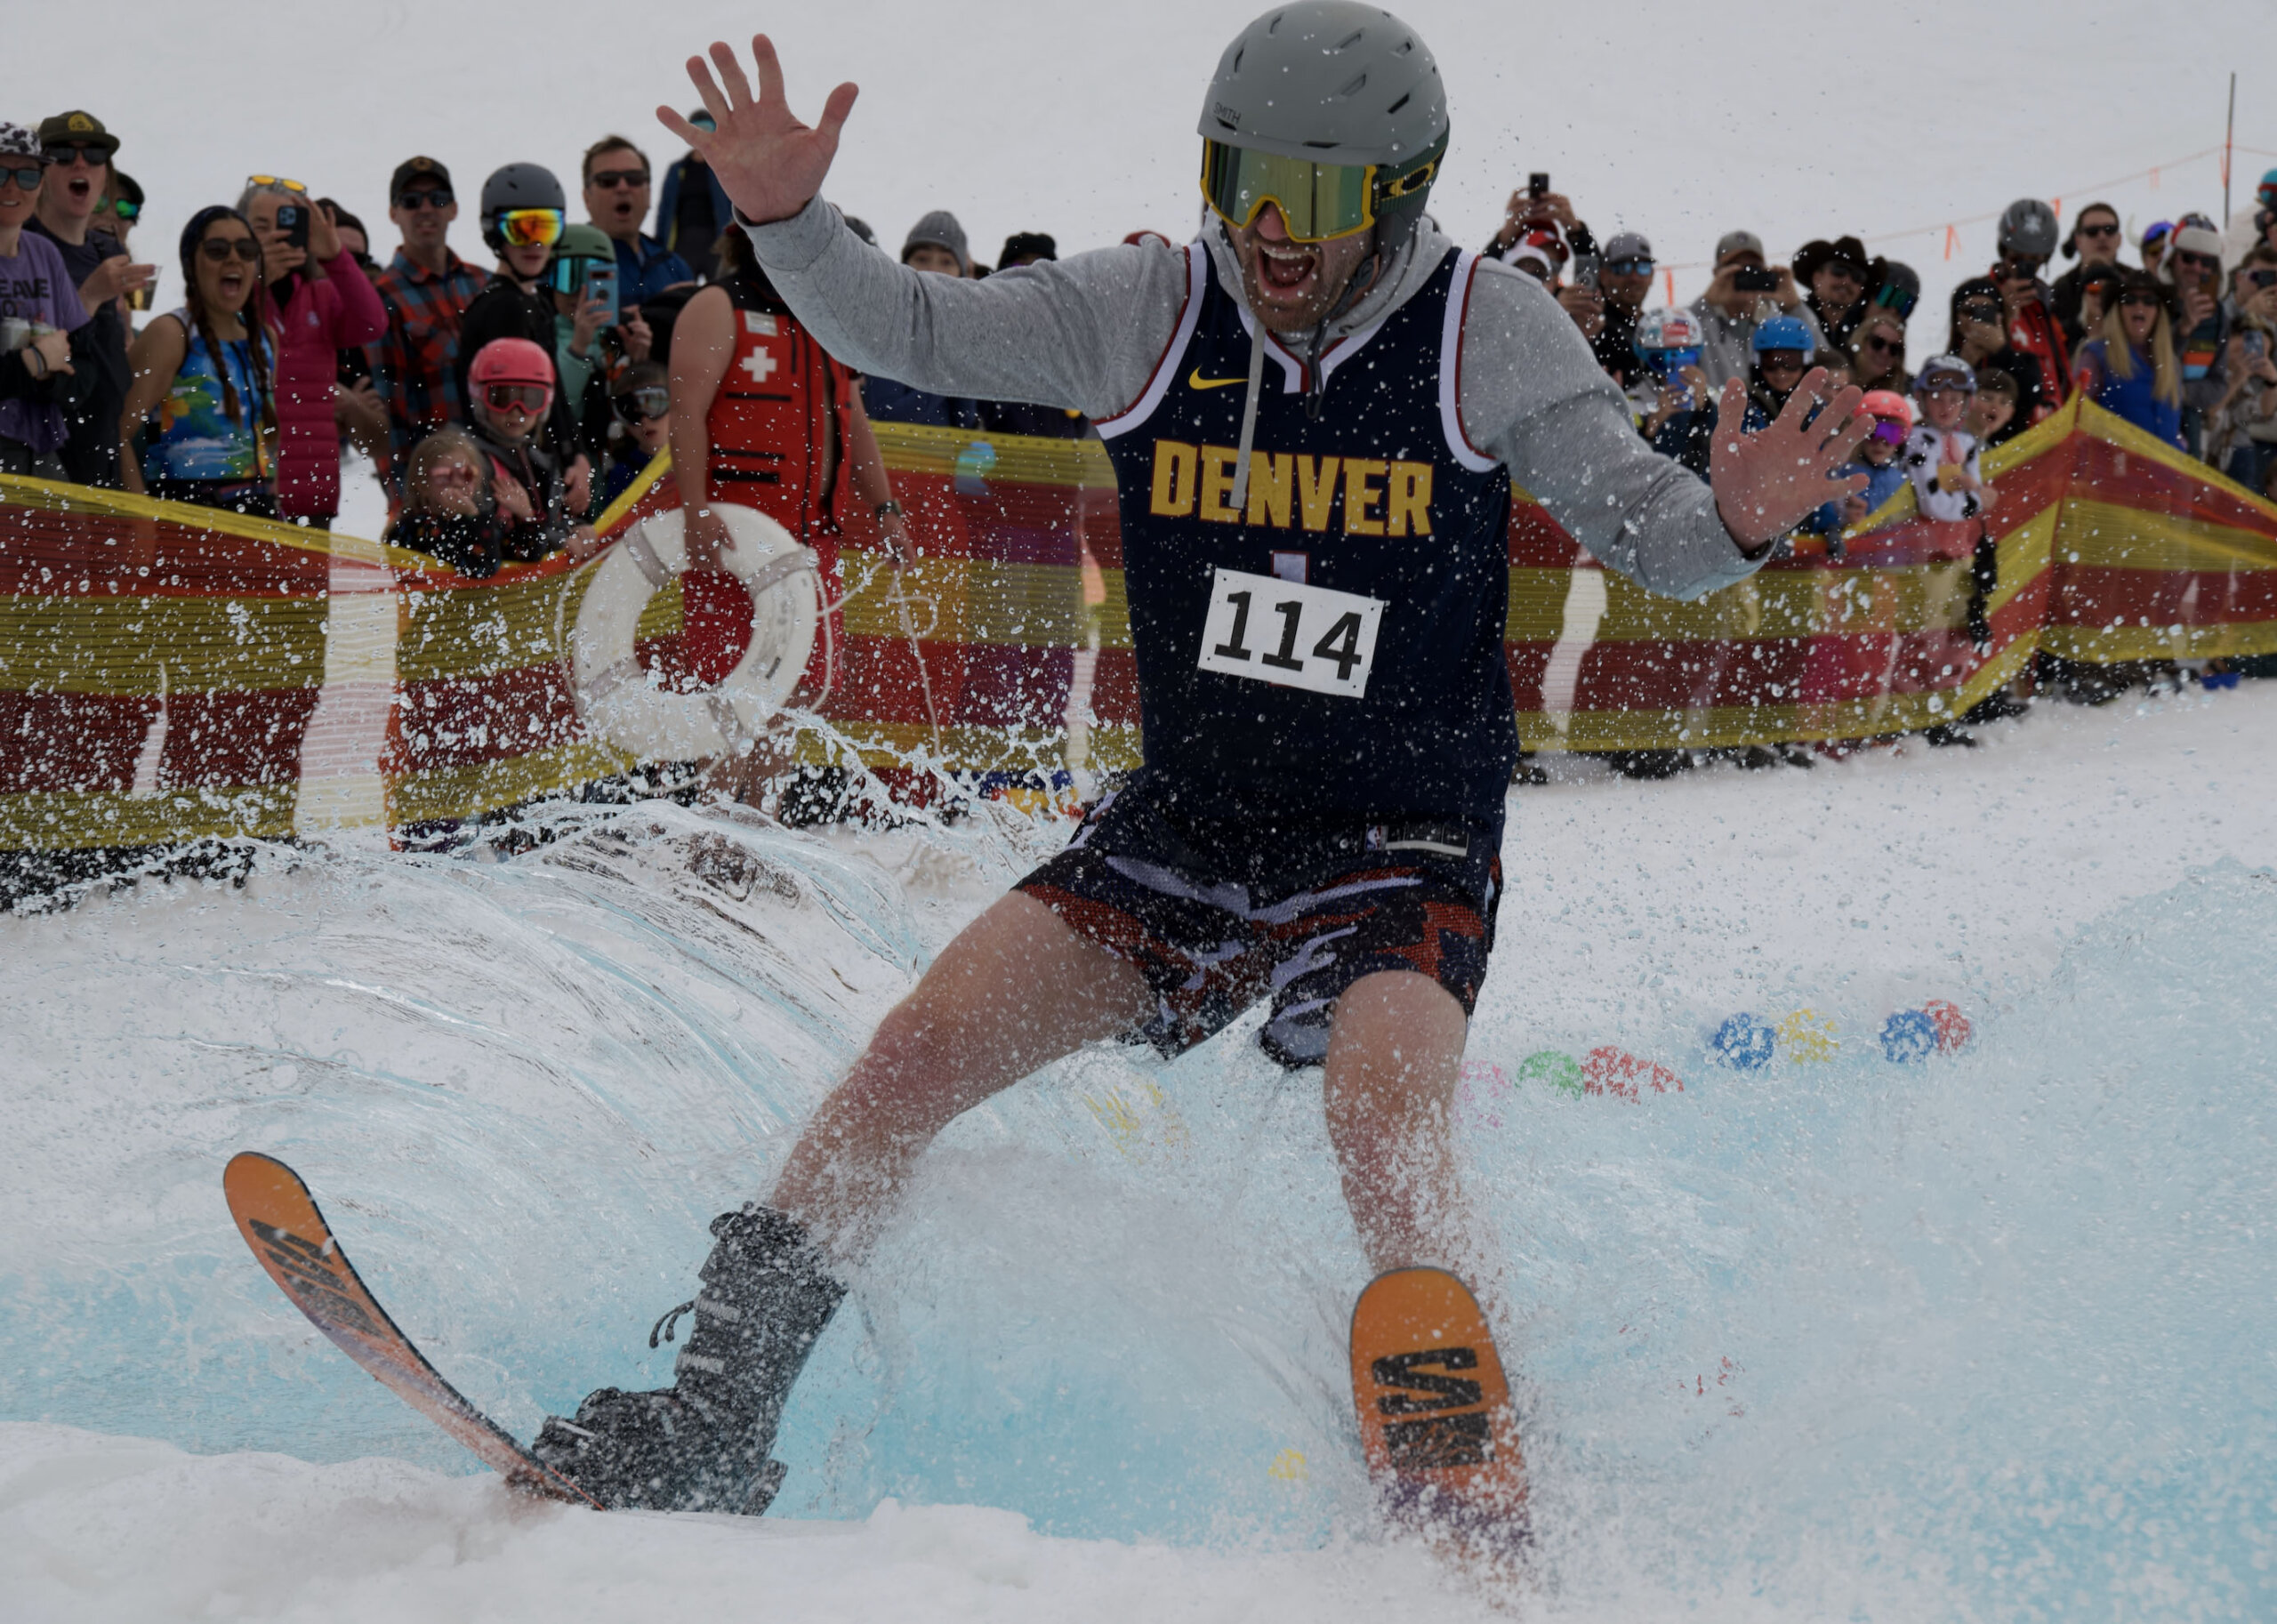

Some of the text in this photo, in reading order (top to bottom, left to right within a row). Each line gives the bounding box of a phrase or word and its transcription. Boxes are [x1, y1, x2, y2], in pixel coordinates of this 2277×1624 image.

[1213, 101, 1242, 125] SMITH
[1149, 439, 1435, 537] DENVER
[1214, 591, 1364, 681] 114
